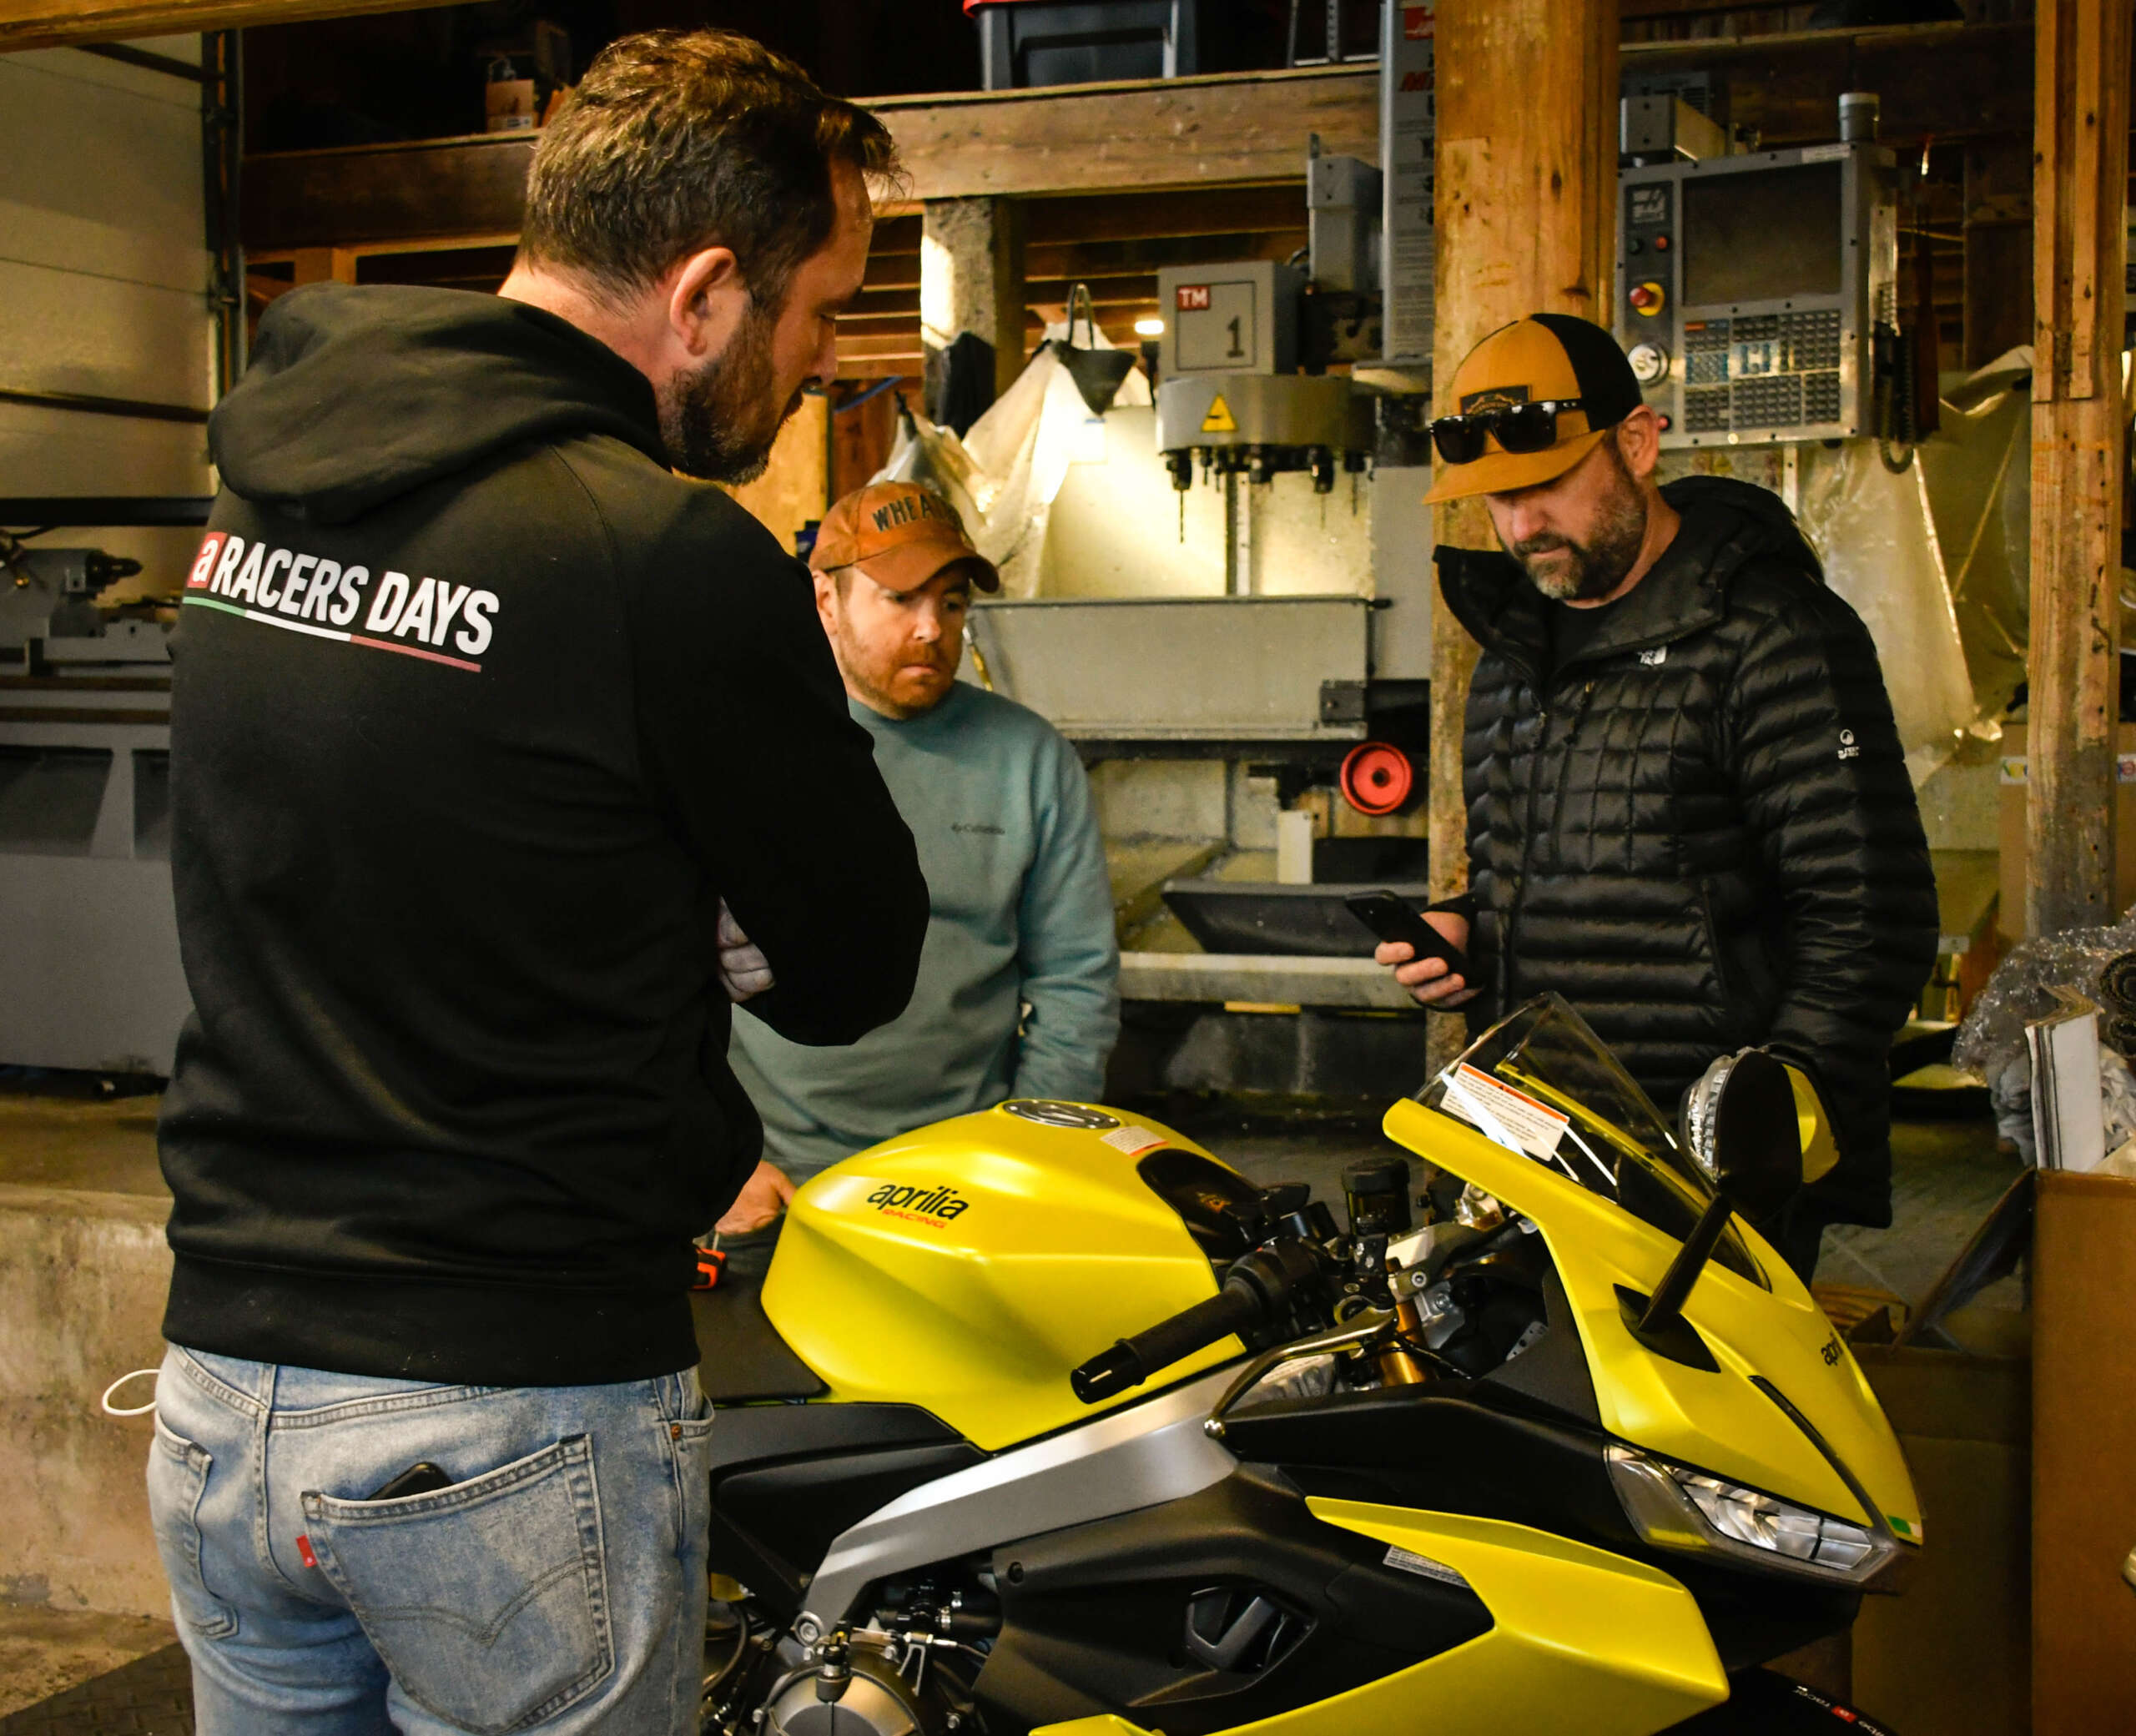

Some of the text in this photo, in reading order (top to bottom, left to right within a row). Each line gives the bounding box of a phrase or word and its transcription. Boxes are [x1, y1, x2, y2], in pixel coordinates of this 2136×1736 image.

[1178, 288, 1208, 308] TM
[1226, 314, 1246, 359] 1
[192, 536, 500, 656] a RACERS DAYS
[867, 1184, 970, 1220] aprilia
[882, 1208, 948, 1229] RACING
